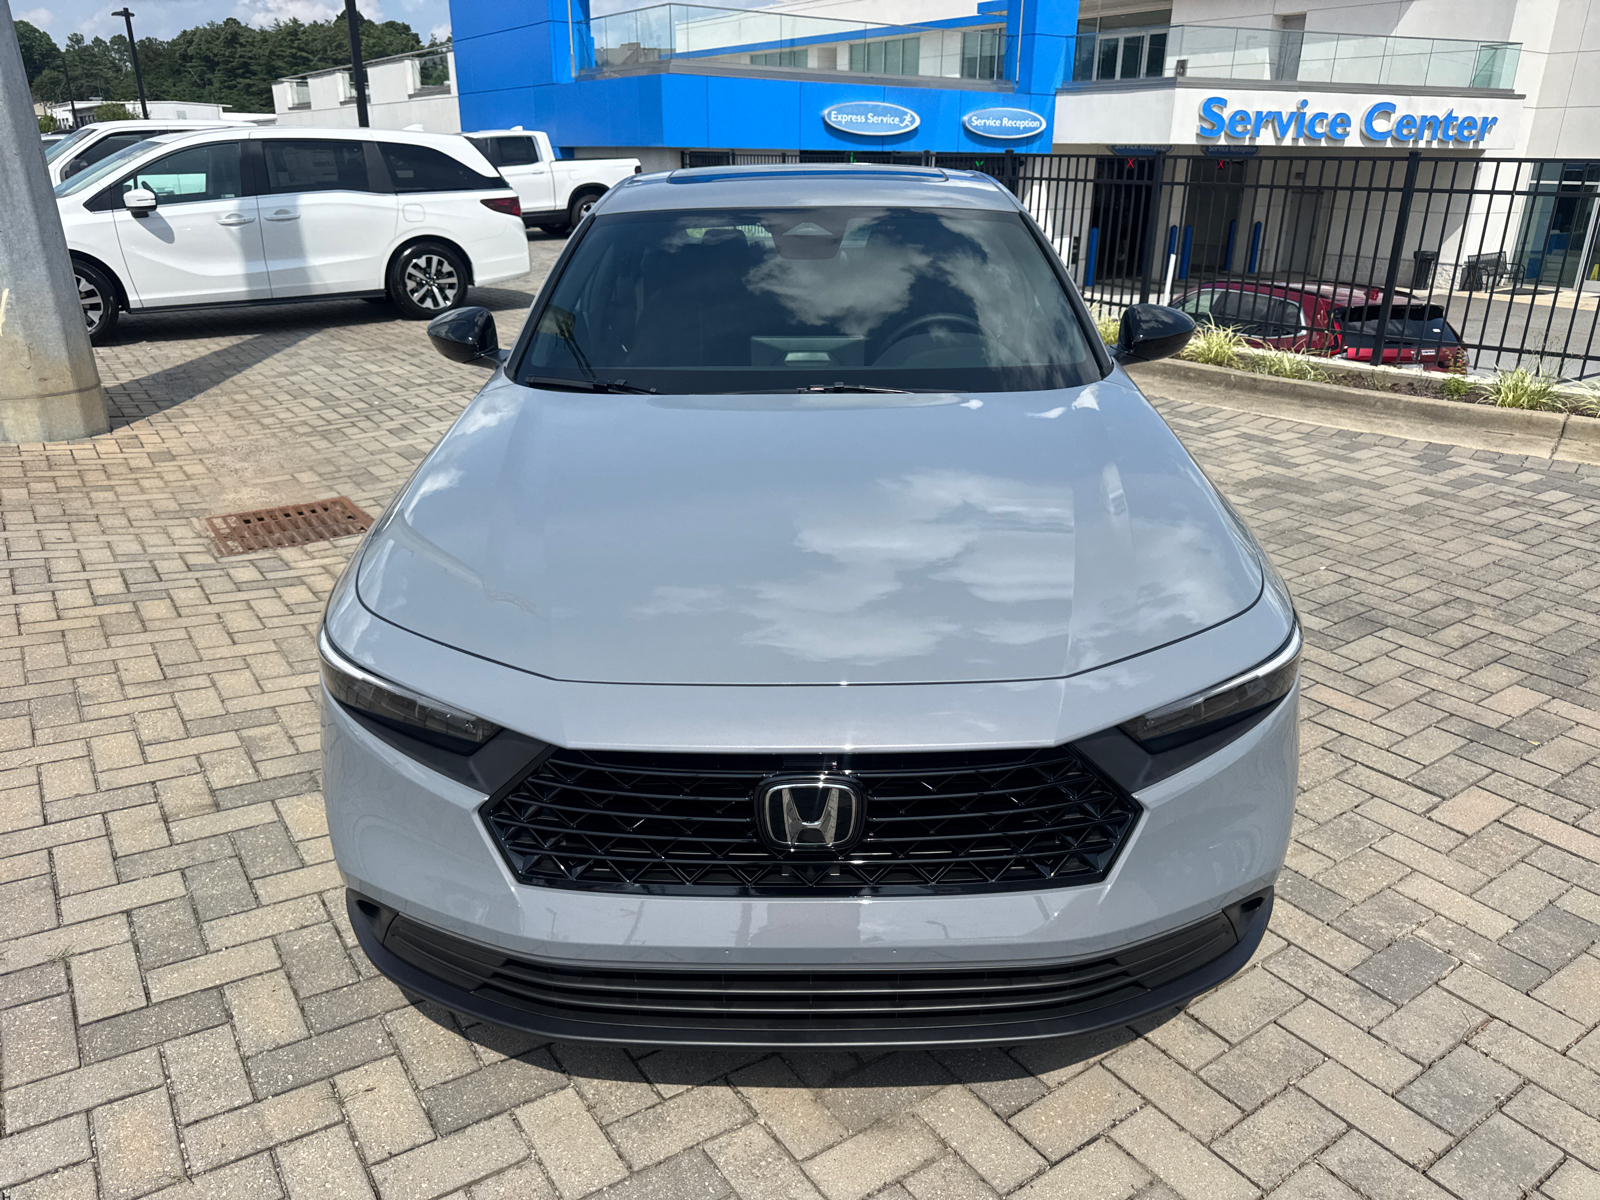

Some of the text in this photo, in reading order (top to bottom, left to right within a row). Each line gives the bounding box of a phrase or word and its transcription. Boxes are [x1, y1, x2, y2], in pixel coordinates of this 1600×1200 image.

[830, 110, 900, 125] Express Service
[971, 115, 1040, 130] Service Reception
[1199, 96, 1499, 142] Service Center
